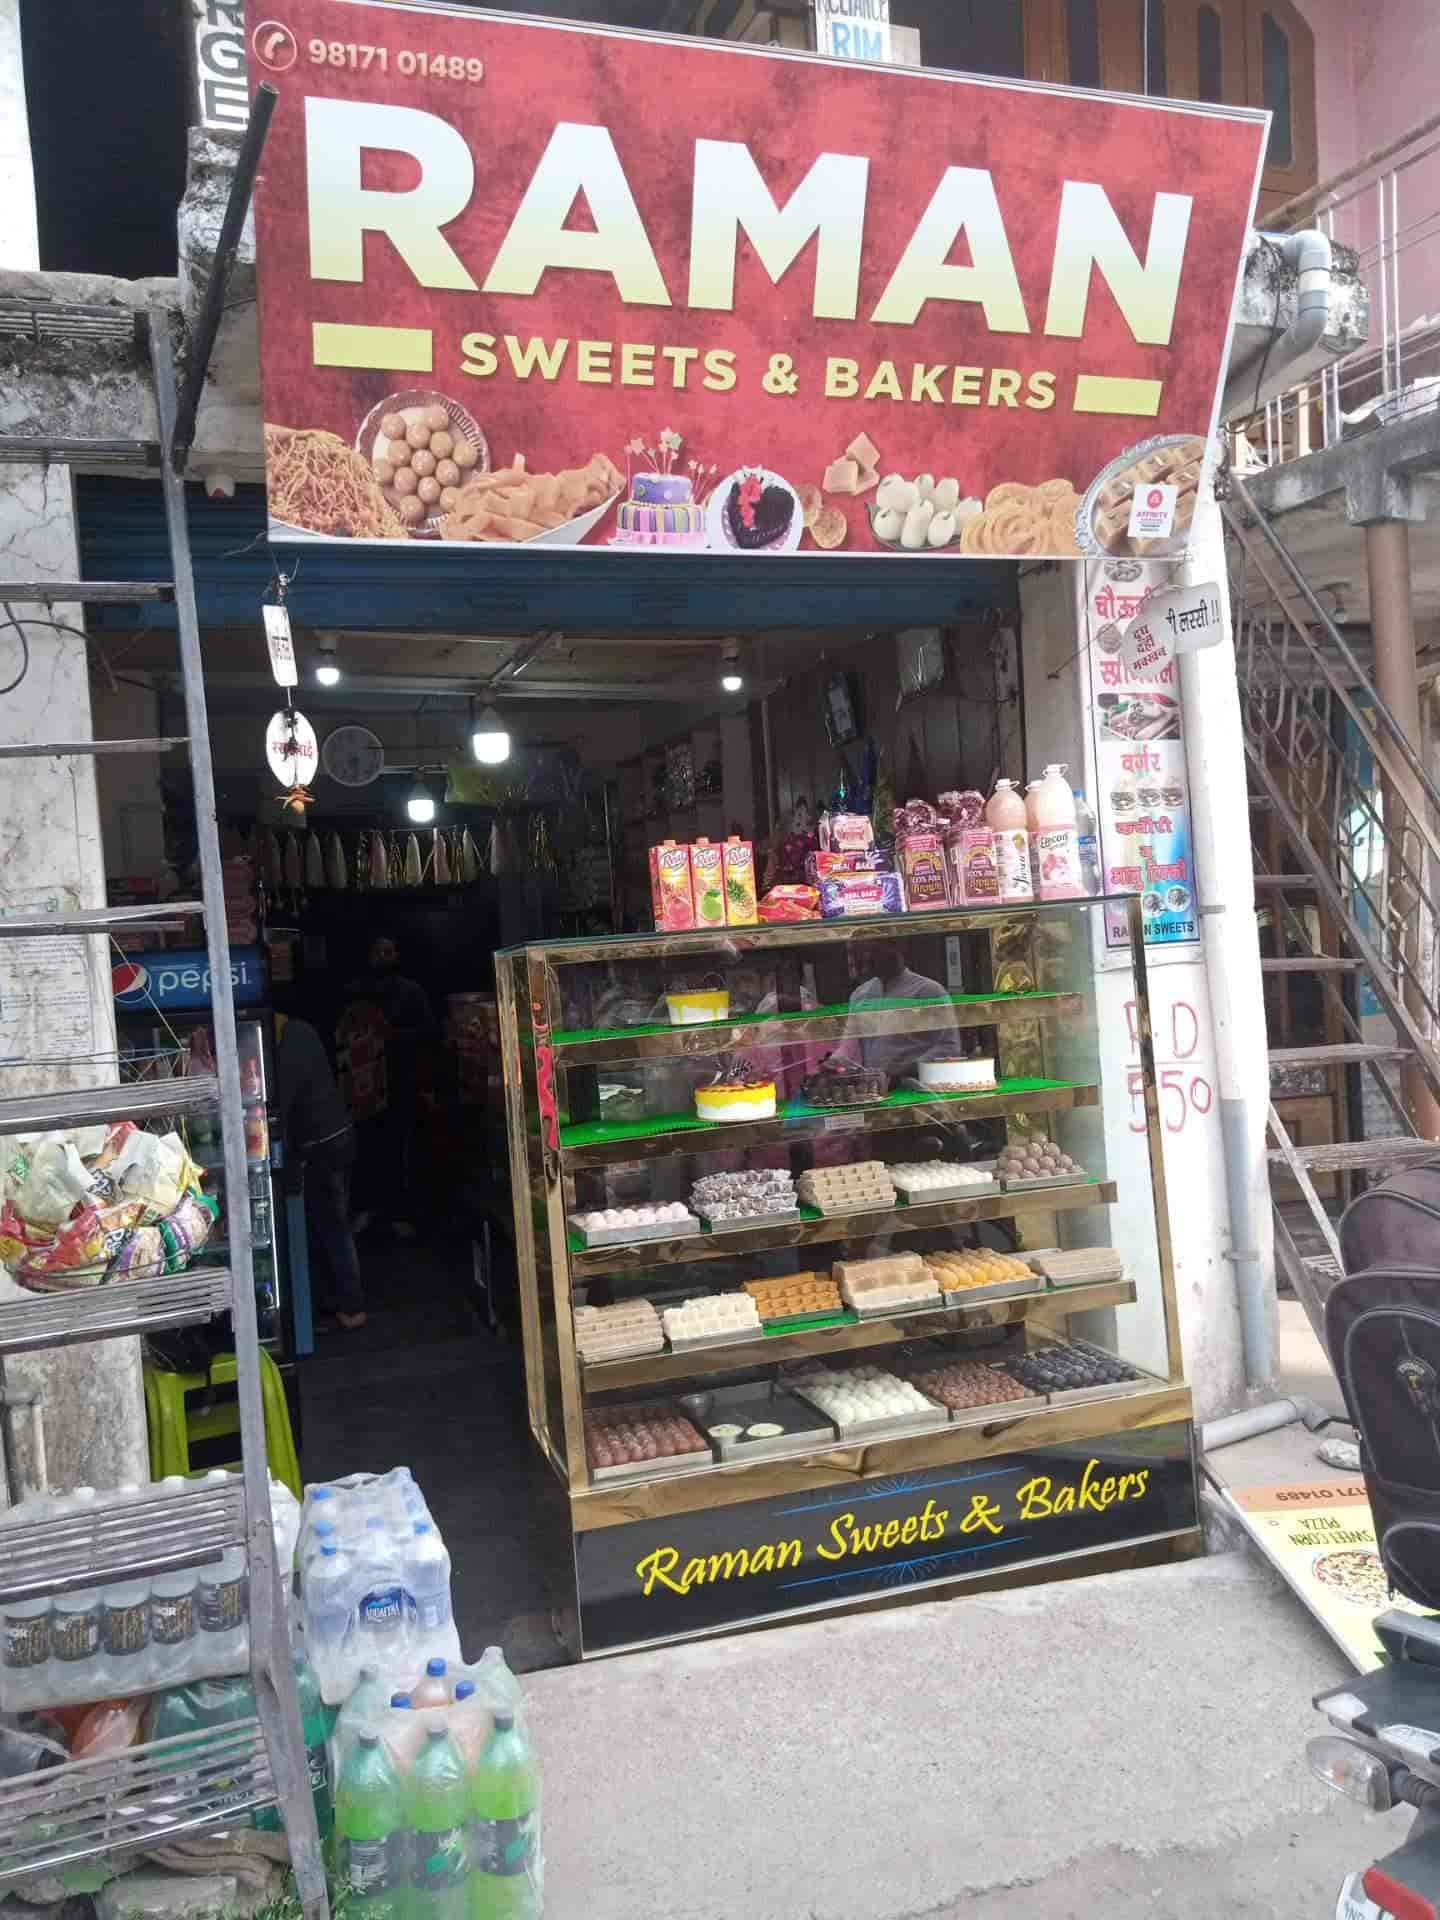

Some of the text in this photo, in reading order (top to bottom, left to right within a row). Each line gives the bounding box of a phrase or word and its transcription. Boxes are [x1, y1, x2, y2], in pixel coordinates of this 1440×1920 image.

[308, 39, 485, 82] 98171 01489
[303, 95, 1194, 346] RAMAN
[460, 332, 1057, 409] SWEETS & BAKERS
[1154, 921, 1194, 936] SWEETS
[636, 1458, 1149, 1596] Raman Sweets & Bakers
[1297, 1516, 1341, 1530] PIZZA
[1331, 1529, 1375, 1544] SWEET
